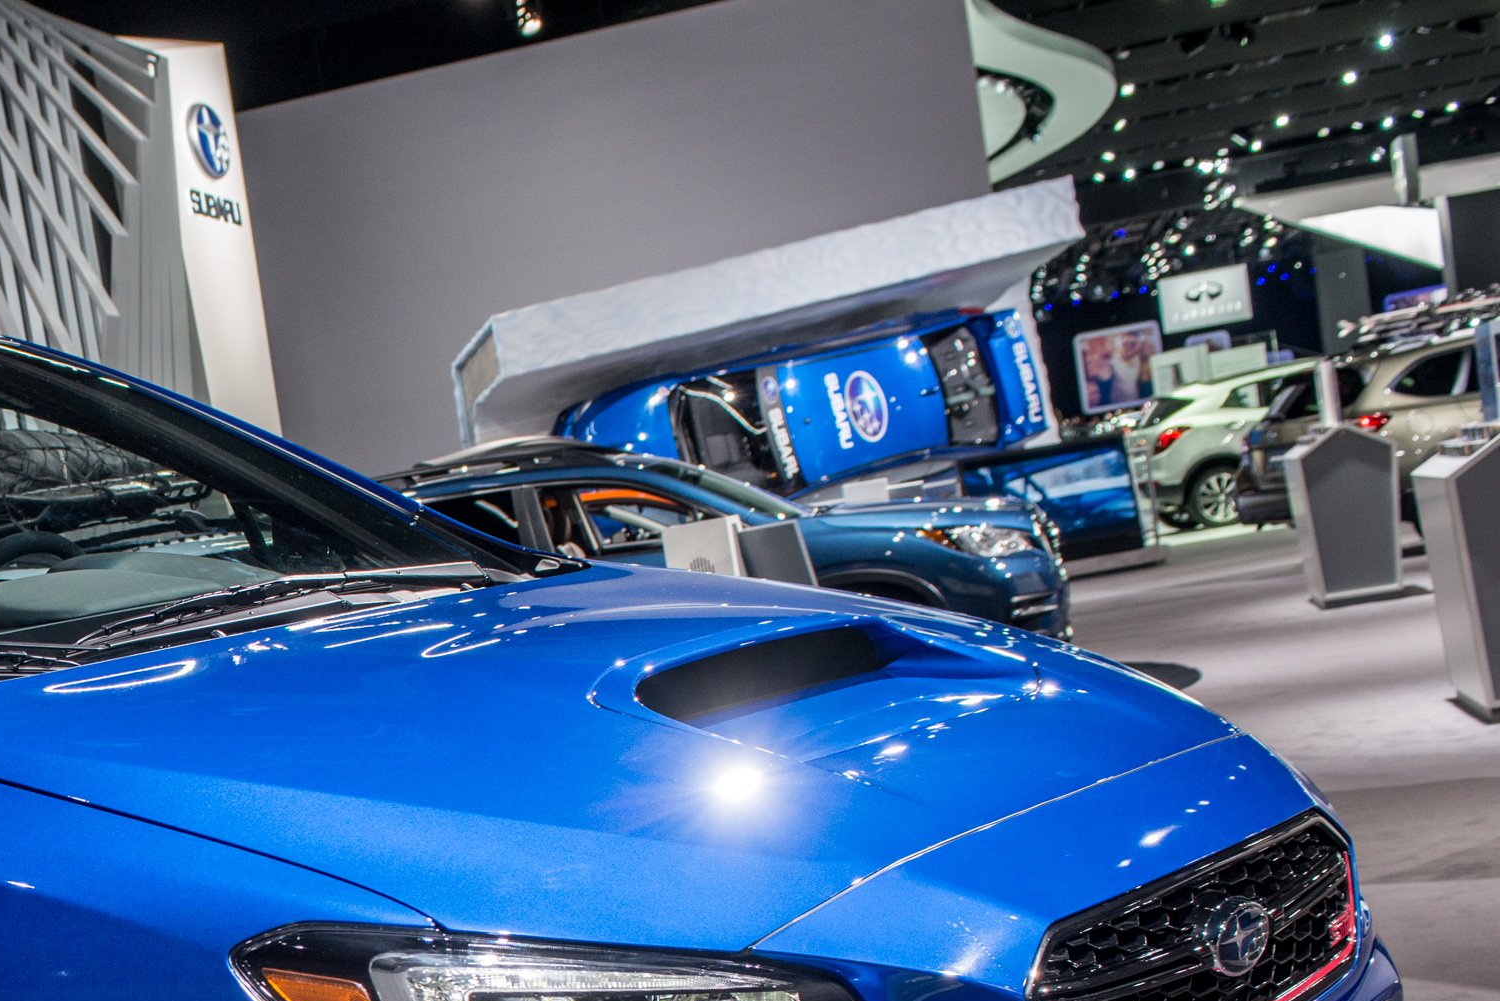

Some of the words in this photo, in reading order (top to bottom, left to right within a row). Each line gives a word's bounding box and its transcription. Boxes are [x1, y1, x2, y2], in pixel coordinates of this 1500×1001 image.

[190, 188, 242, 227] SUBARU
[824, 372, 855, 449] SUBARU
[1011, 341, 1043, 423] SUBARU
